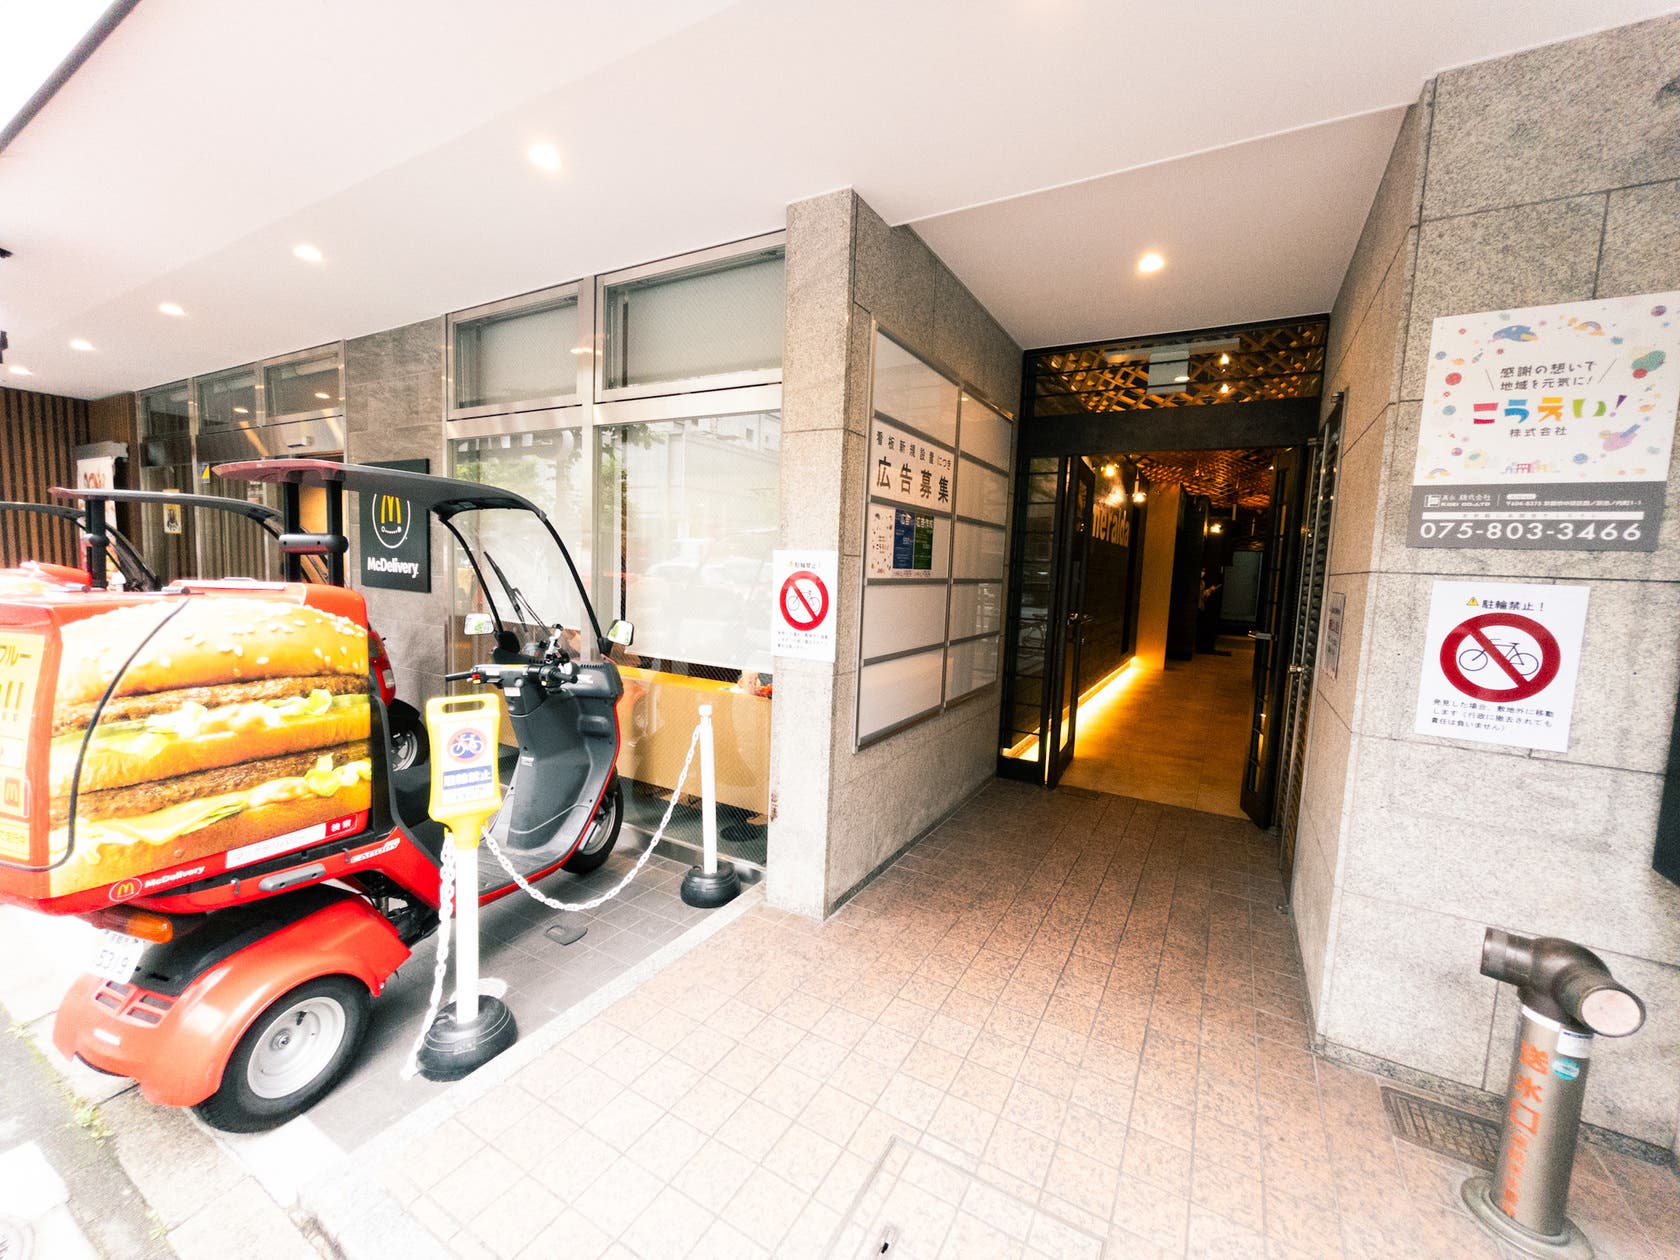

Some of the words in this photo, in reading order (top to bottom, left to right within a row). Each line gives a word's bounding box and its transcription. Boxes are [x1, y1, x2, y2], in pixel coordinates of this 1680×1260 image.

[1510, 427, 1567, 438] 株式会社
[876, 456, 949, 503] 広告募集
[1420, 522, 1641, 540] 075-803-3466
[367, 556, 418, 579] McDelivery
[144, 866, 206, 888] McDelivery
[1509, 1040, 1549, 1136] 送水口
